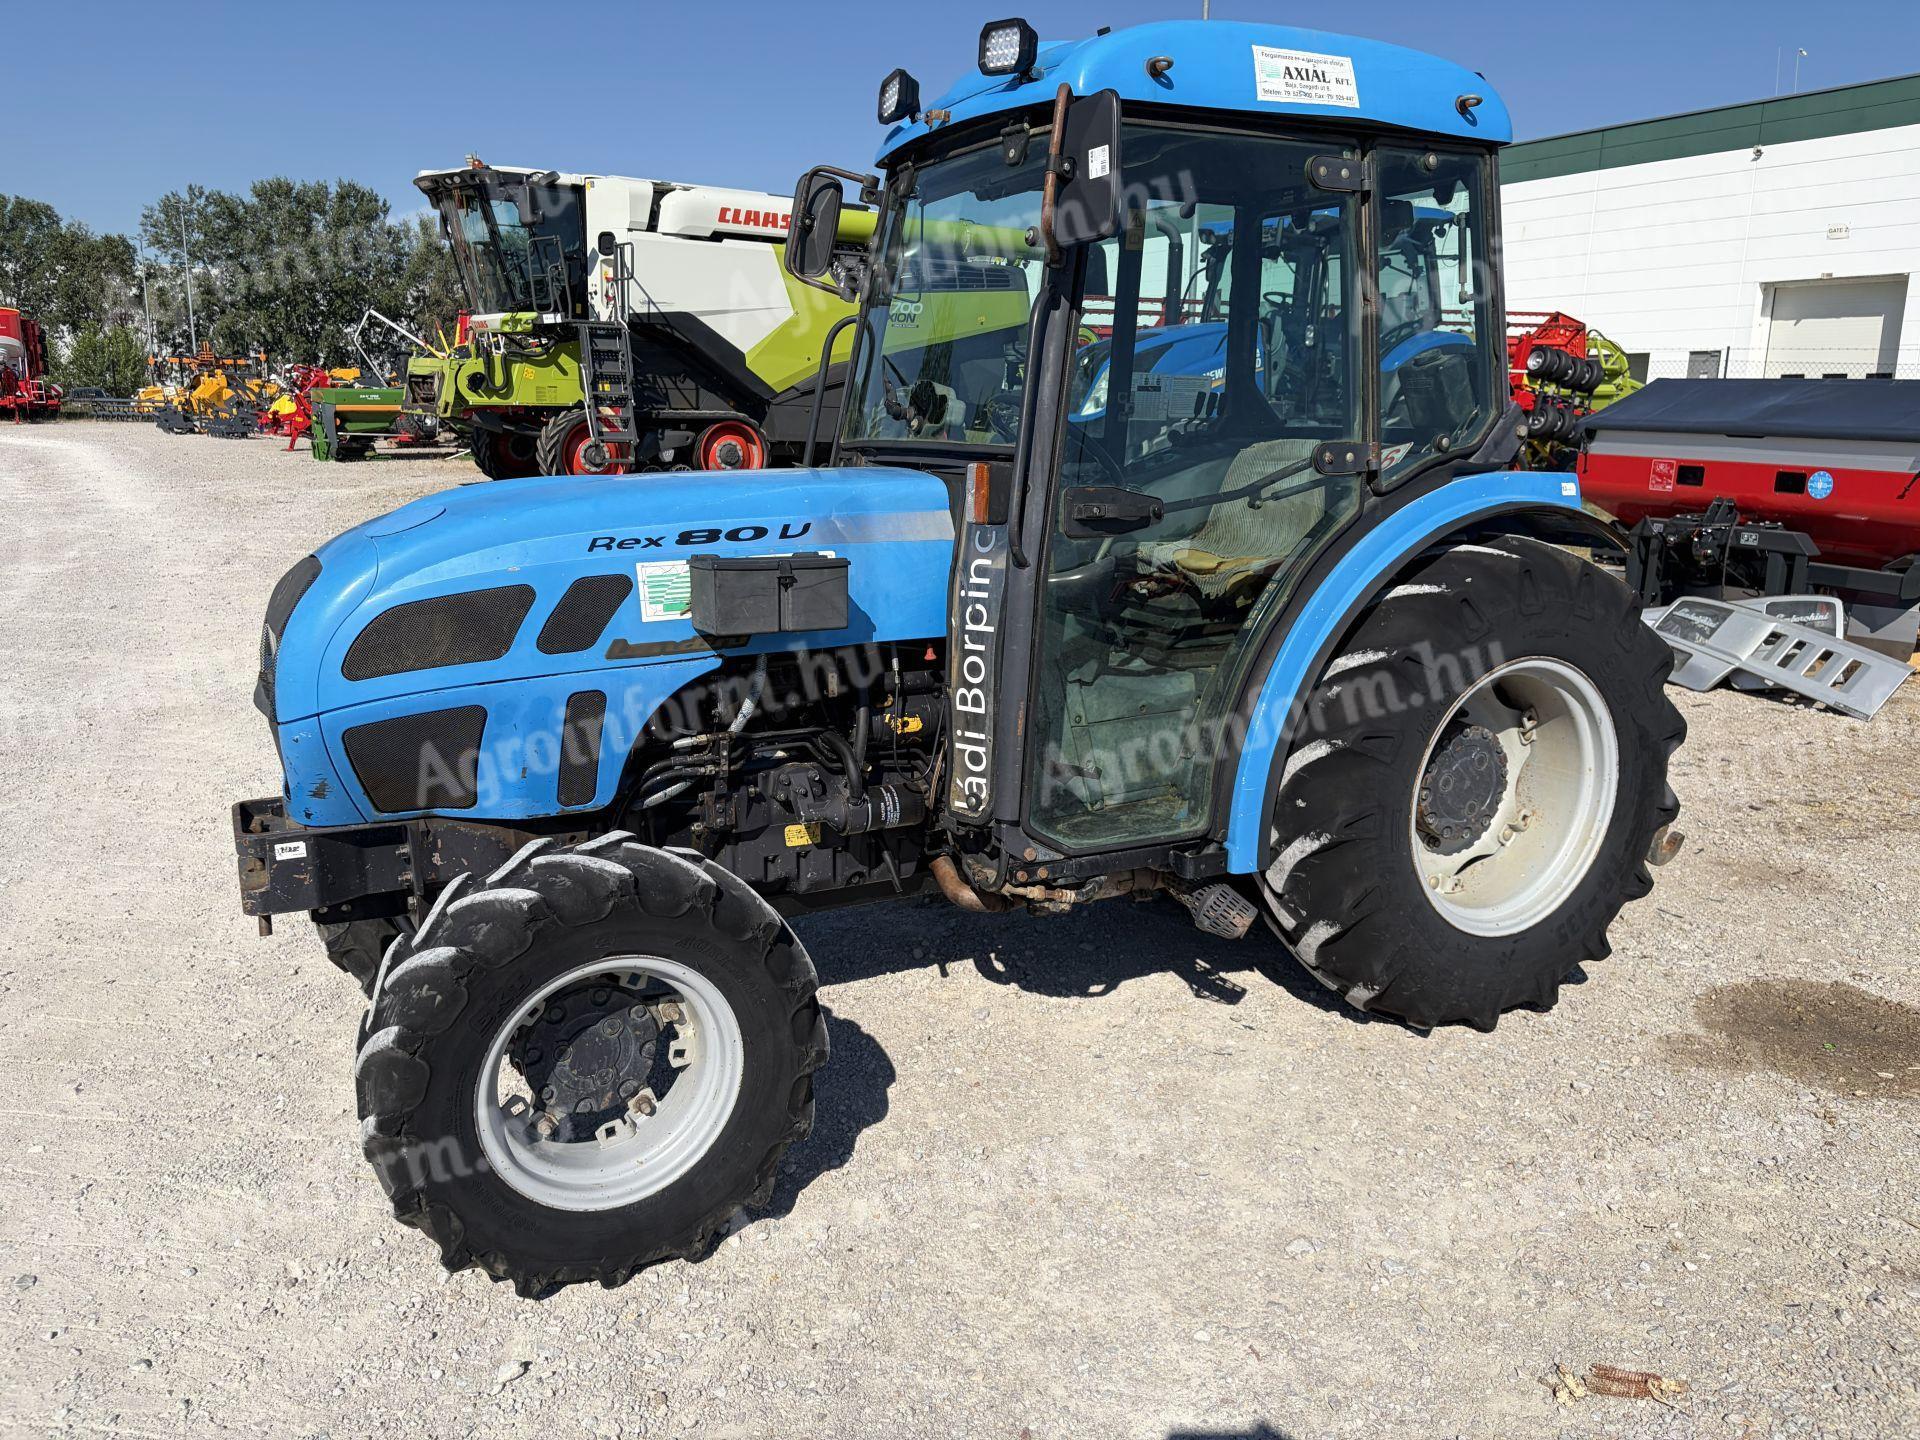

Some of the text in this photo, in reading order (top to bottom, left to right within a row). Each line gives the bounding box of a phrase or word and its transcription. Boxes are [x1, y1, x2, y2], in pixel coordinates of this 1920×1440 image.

[718, 207, 791, 229] CLAAS
[588, 536, 666, 553] Rex
[675, 526, 769, 546] 80
